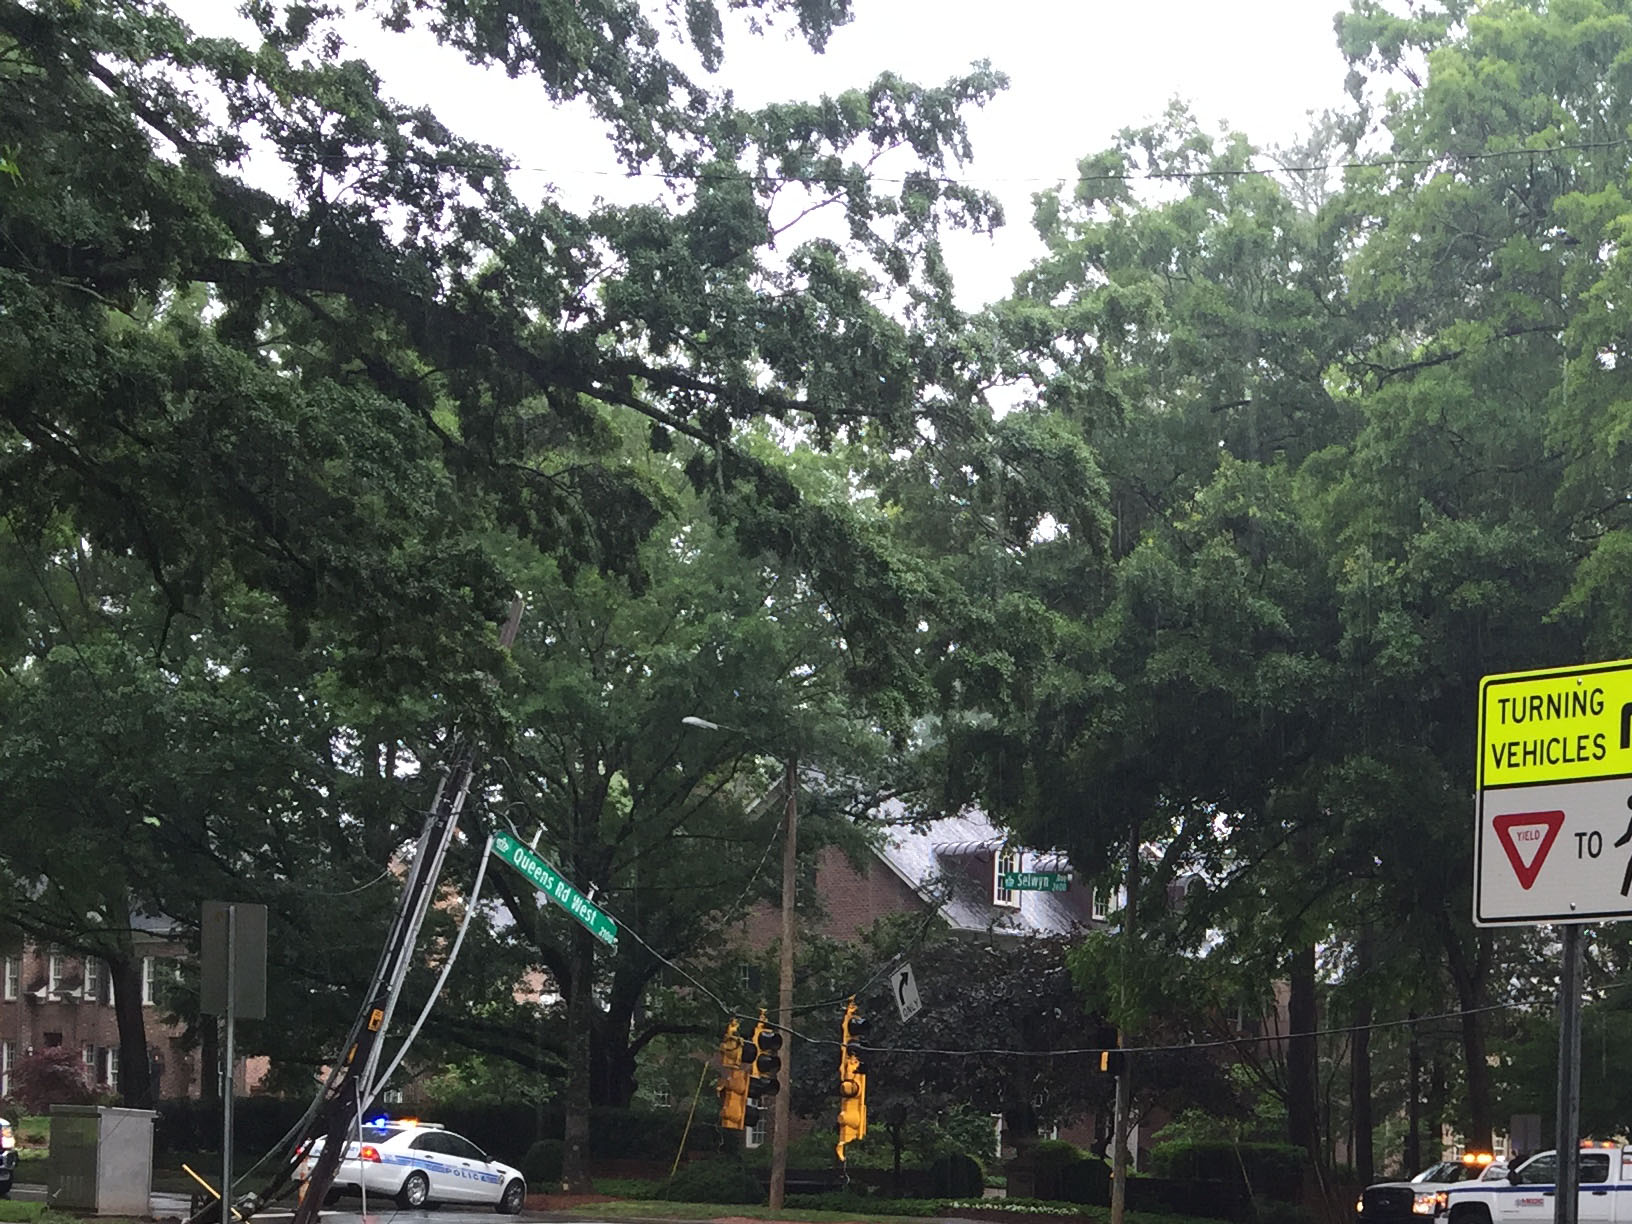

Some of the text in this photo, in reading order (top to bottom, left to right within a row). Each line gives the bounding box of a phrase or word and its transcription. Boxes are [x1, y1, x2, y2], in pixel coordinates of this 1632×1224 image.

[1498, 688, 1604, 725] TURNING
[1491, 733, 1606, 769] VEHICLES
[1516, 829, 1603, 859] YIELD TO
[513, 848, 597, 926] Queens Rd West
[1017, 873, 1049, 890] Selwyn
